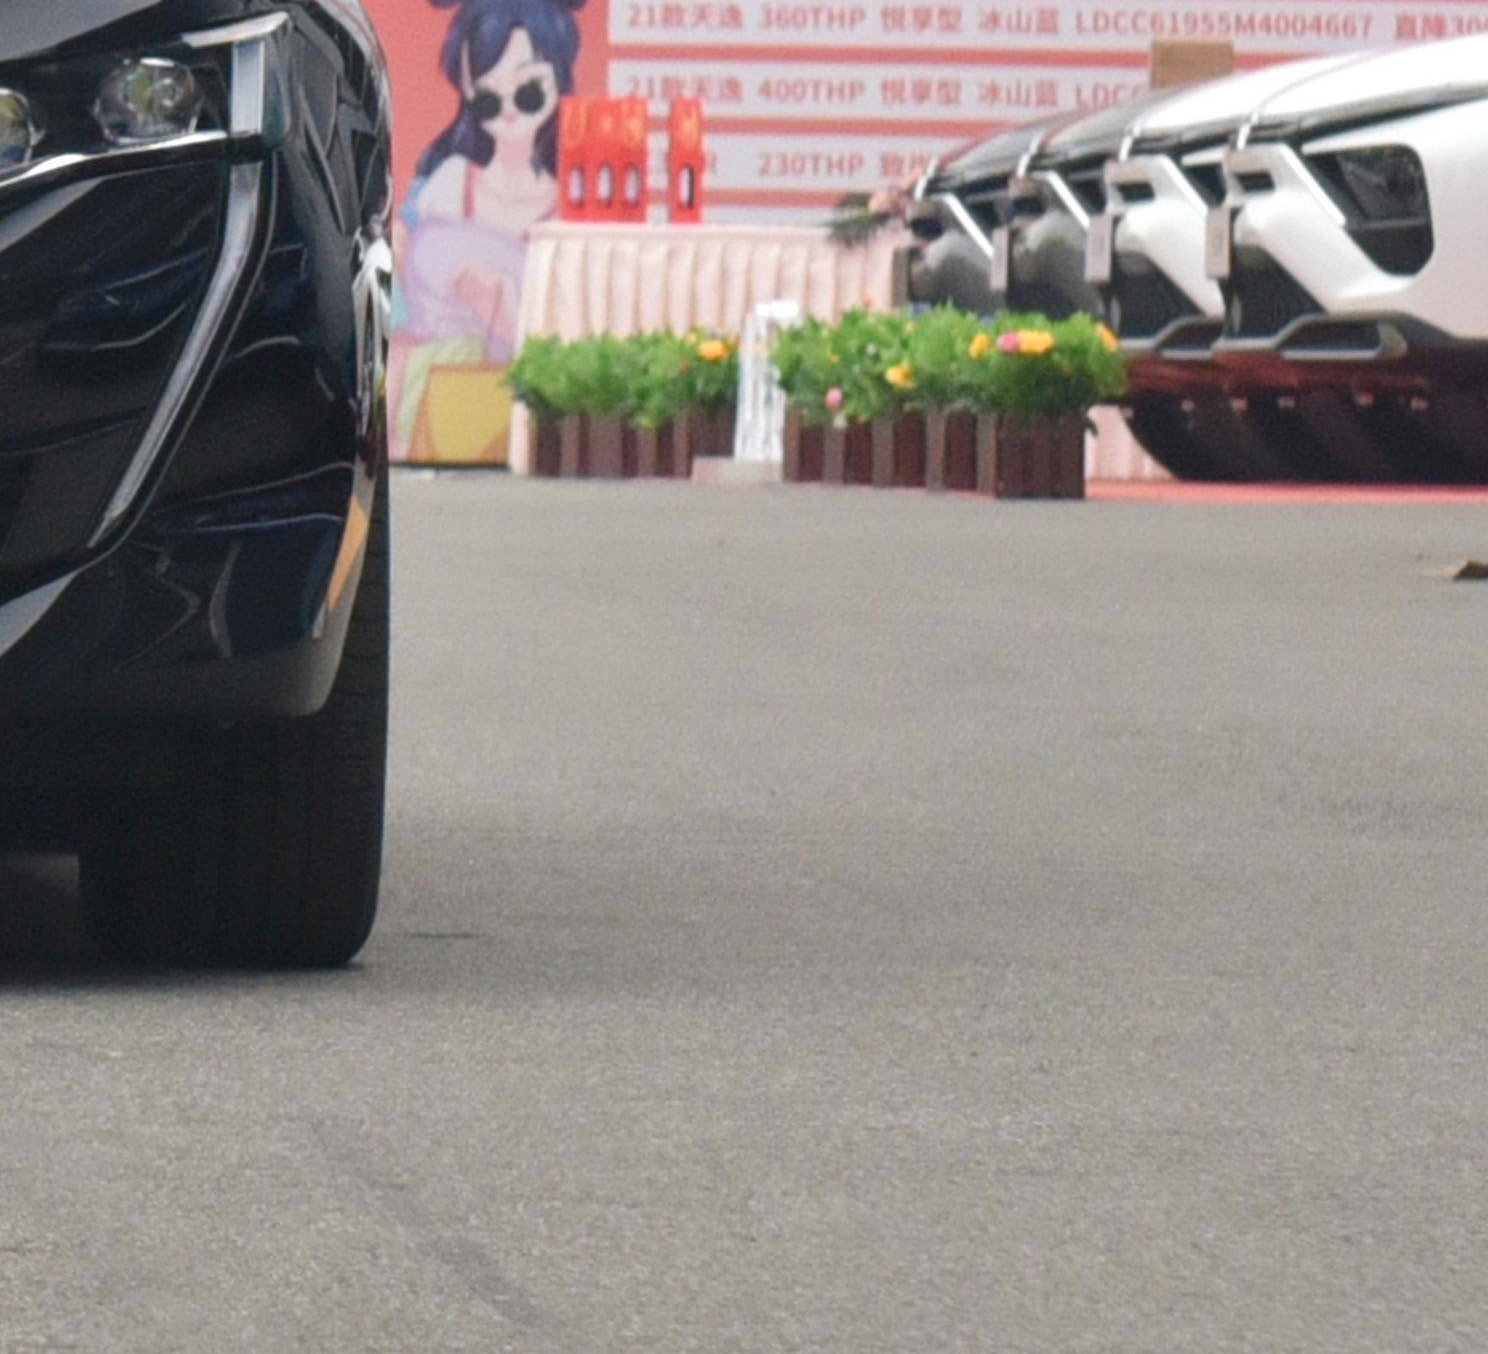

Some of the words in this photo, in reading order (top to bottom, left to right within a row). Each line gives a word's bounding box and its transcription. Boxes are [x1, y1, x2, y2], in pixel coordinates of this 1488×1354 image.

[758, 3, 866, 32] 360THP
[1075, 7, 1373, 39] LDCC61955M4004667
[757, 75, 866, 104] 400THP
[756, 150, 865, 178] 230THP
